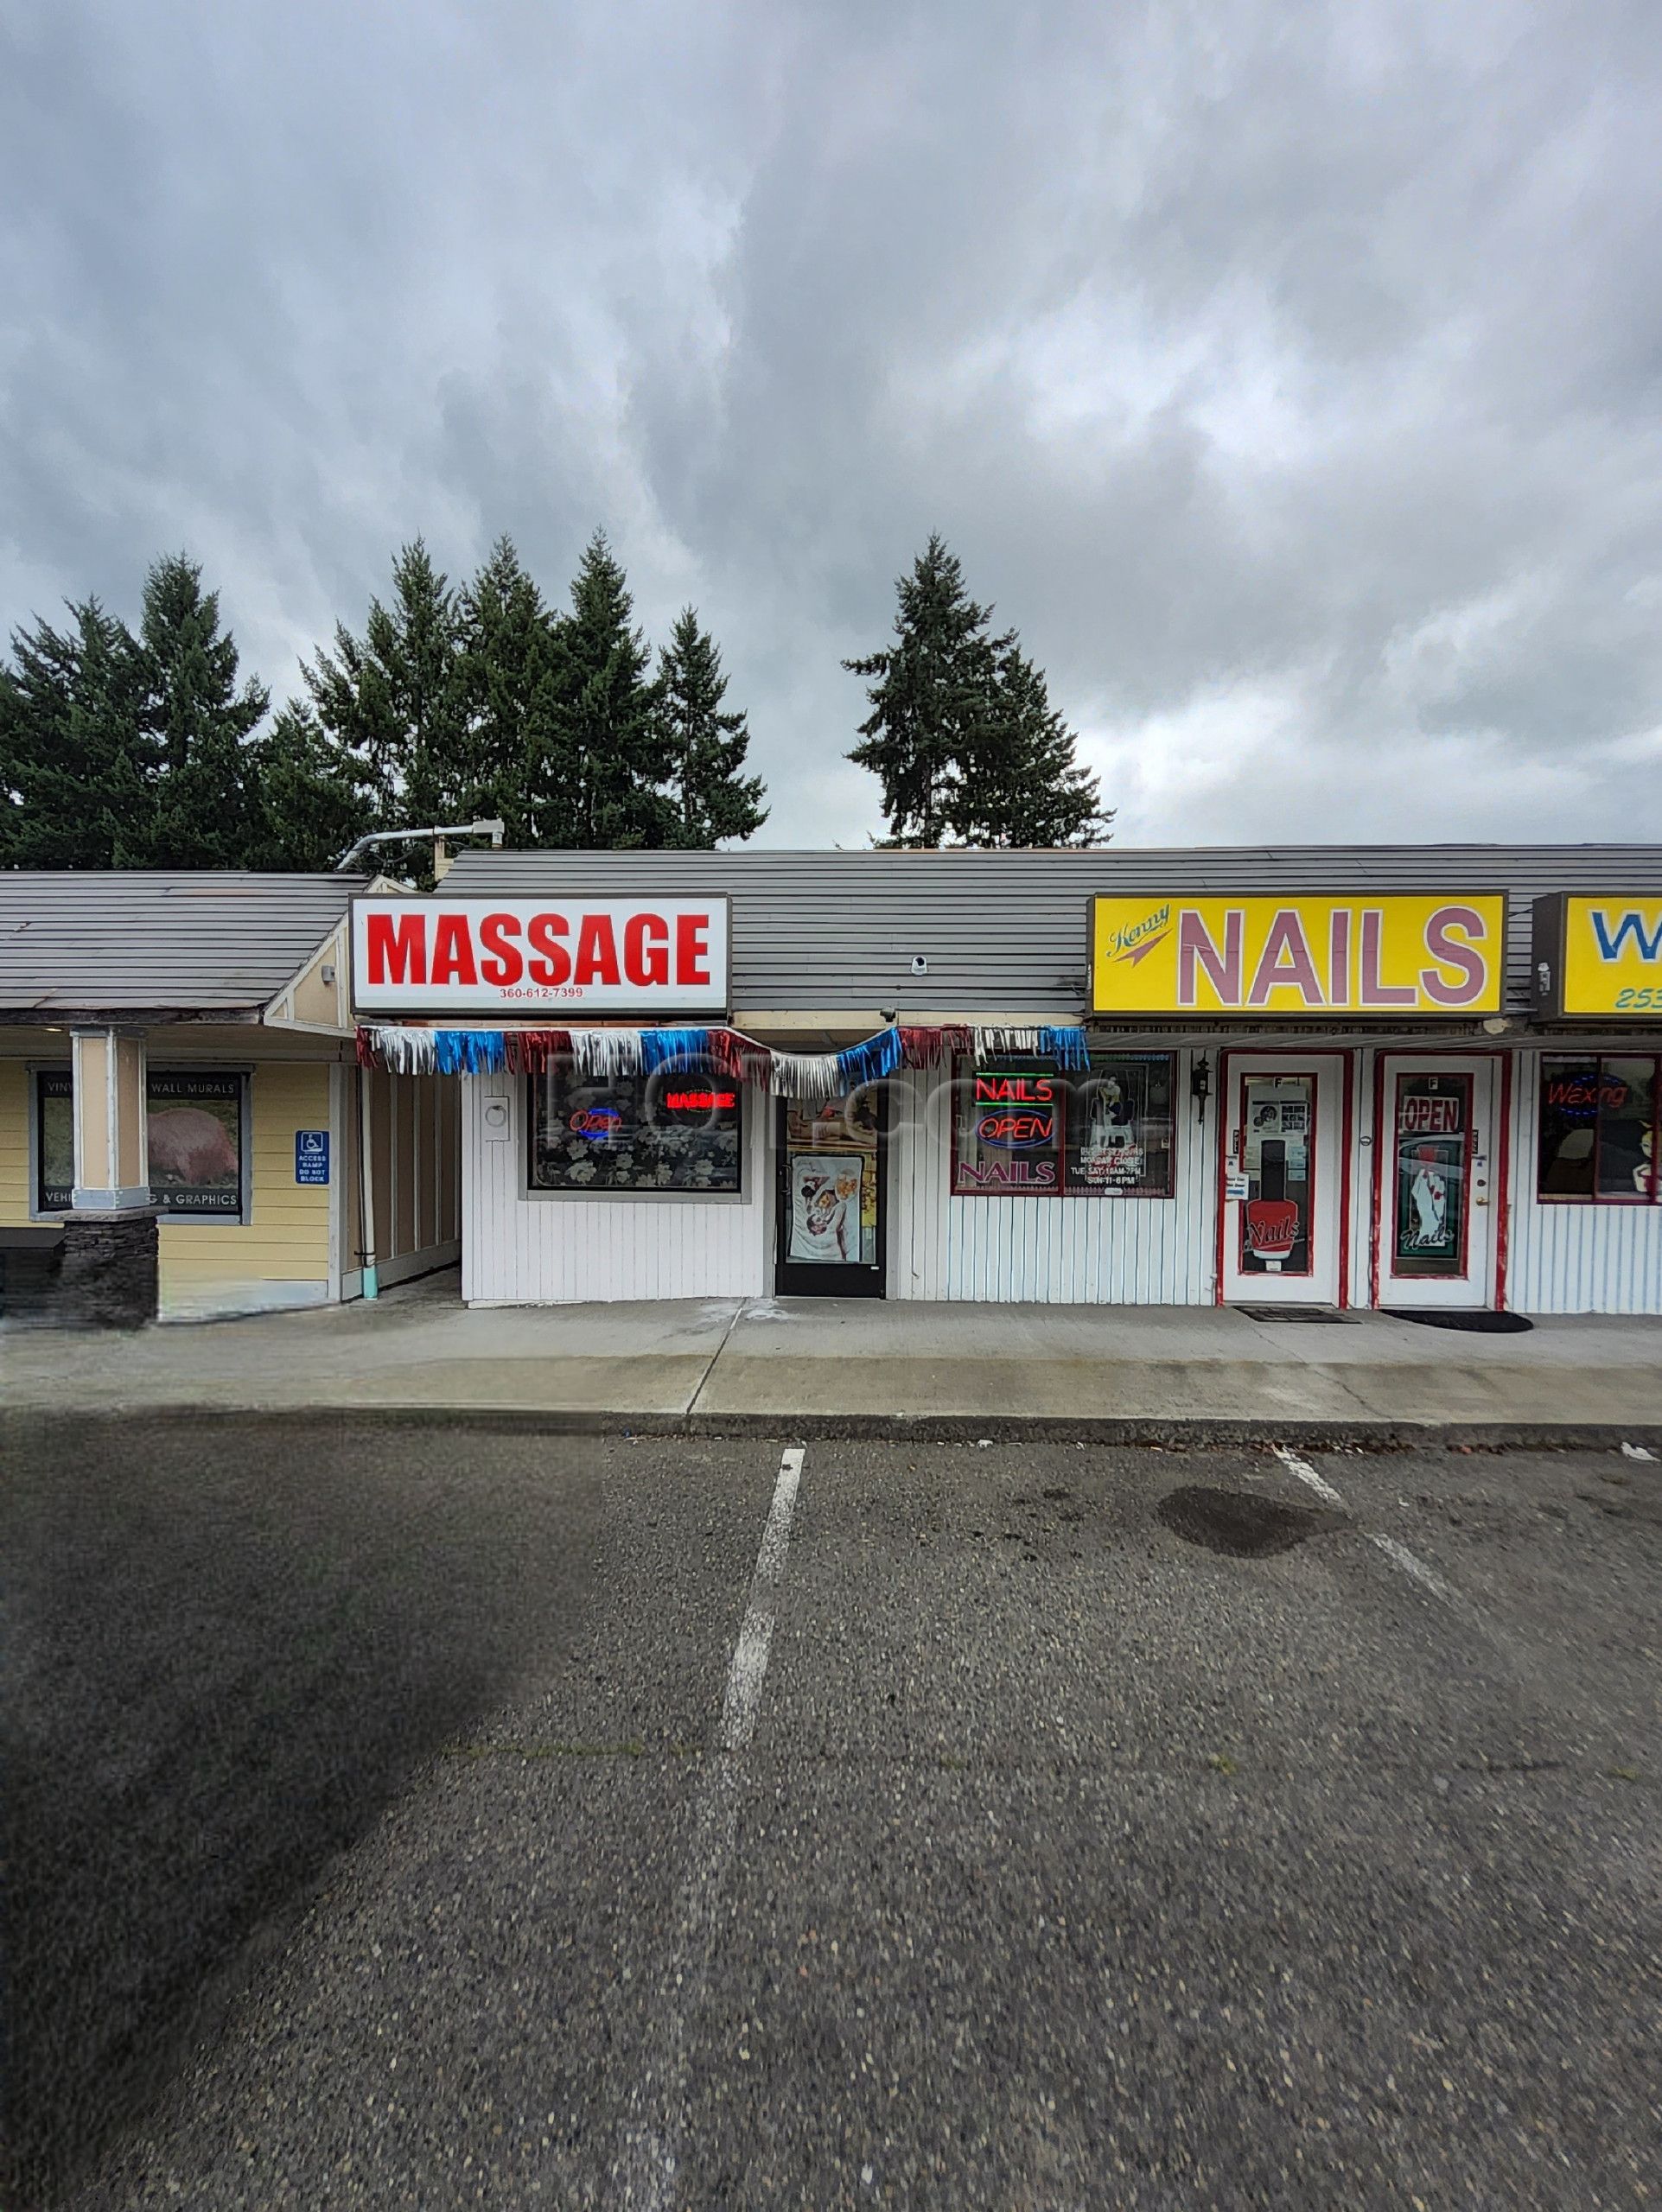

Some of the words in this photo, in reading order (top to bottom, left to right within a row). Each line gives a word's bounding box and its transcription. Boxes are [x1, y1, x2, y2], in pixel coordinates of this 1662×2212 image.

[1106, 904, 1170, 957] Kenny
[366, 912, 711, 987] MASSAGE
[1176, 906, 1488, 1007] NAILS
[500, 988, 583, 998] 360-612-7399
[151, 1083, 183, 1093] WALL
[188, 1084, 235, 1094] MURALS
[976, 1077, 1053, 1101] NAILS
[1404, 1097, 1459, 1132] OPEN
[979, 1117, 1053, 1138] OPEN
[958, 1161, 1055, 1184] NAILS
[162, 1194, 171, 1204] &
[175, 1194, 237, 1205] GRAPHICS
[1247, 1216, 1300, 1246] Nails
[1400, 1225, 1454, 1250] Nails
